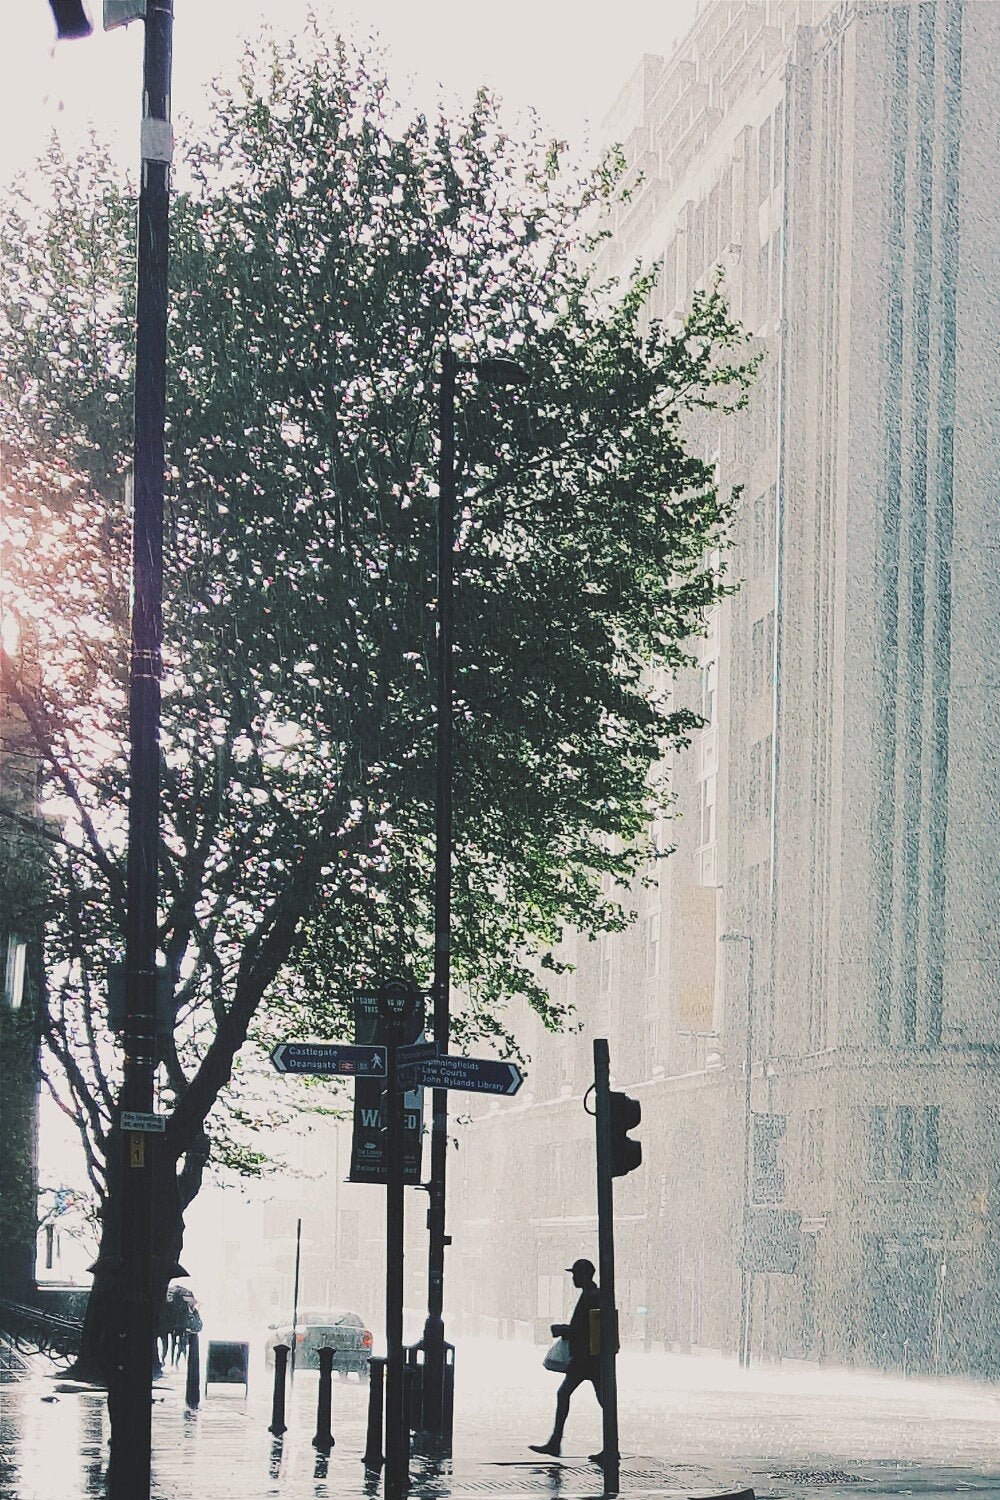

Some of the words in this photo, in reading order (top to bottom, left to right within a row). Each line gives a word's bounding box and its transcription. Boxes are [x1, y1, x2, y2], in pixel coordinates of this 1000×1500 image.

[289, 1060, 337, 1069] Deansgate
[422, 1066, 437, 1074] Law
[440, 1067, 467, 1077] Courts
[422, 1075, 441, 1084] John
[444, 1076, 475, 1088] Rylands
[478, 1080, 504, 1092] Library
